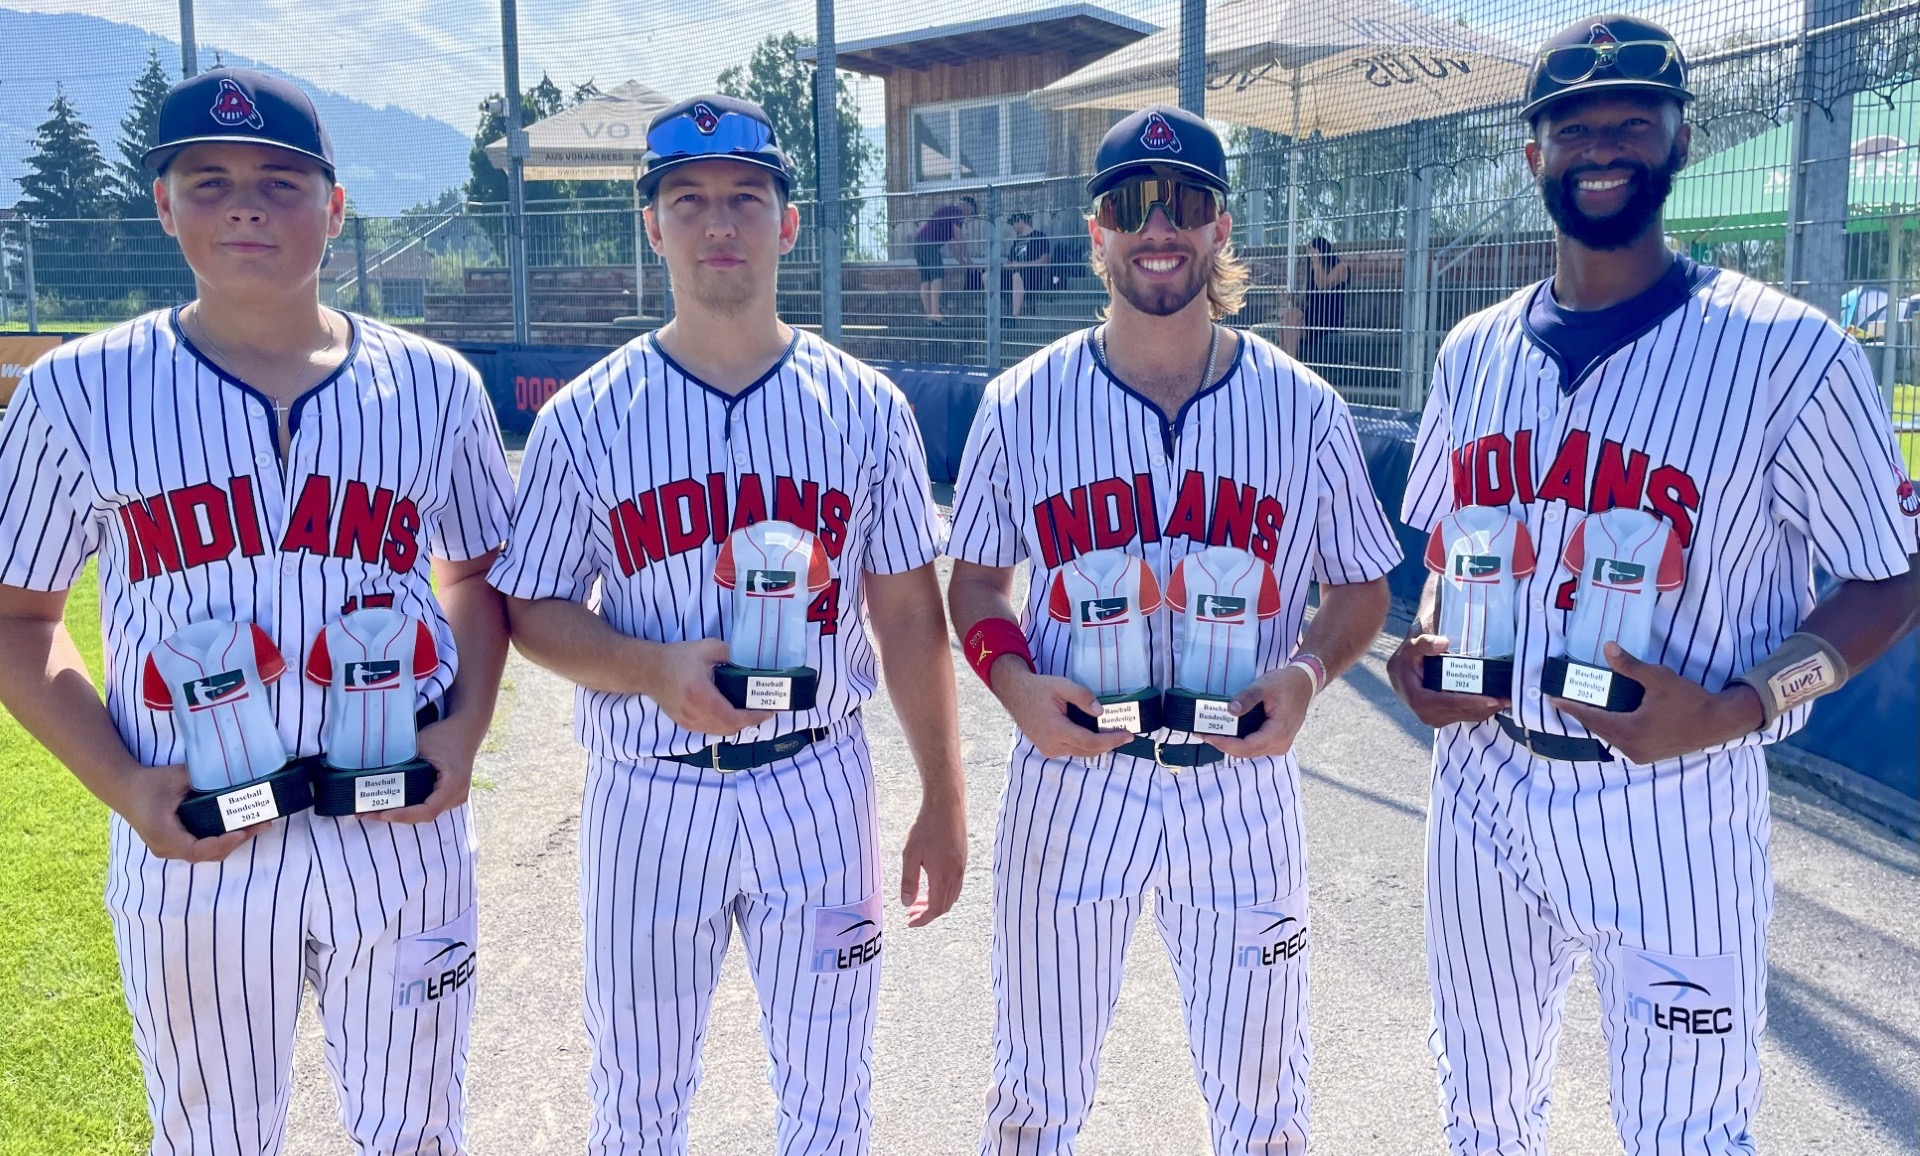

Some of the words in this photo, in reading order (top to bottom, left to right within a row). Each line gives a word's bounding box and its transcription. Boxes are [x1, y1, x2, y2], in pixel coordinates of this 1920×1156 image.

[545, 153, 563, 162] AUS
[565, 153, 624, 162] VORARLBERG
[515, 376, 566, 412] DOR
[1451, 428, 1700, 549] NDIANS
[608, 472, 852, 578] INDIANS
[1033, 469, 1285, 571] INDIANS
[118, 473, 420, 585] INDIANS
[1450, 661, 1476, 671] Baseball
[1446, 670, 1480, 680] Bundesliga
[1575, 669, 1603, 682] Baseball
[755, 680, 784, 688] Baseball
[1455, 680, 1470, 689] 2024
[1568, 677, 1605, 692] Bundesliga
[751, 690, 787, 698] Bundesliga
[1577, 689, 1593, 699] 2024
[1105, 705, 1131, 715] Baseball
[1204, 703, 1227, 713] Baseba
[1101, 714, 1136, 724] Bundesliga
[1199, 712, 1235, 723] Bundesliga
[1208, 722, 1224, 731] 2024
[364, 777, 396, 788] Baseball
[228, 788, 262, 805] Baseball
[360, 787, 401, 799] Bundesliga
[226, 798, 270, 816] Bundesliga
[371, 798, 389, 807] 2024
[241, 811, 261, 823] 2024
[1627, 991, 1733, 1035] intREC
